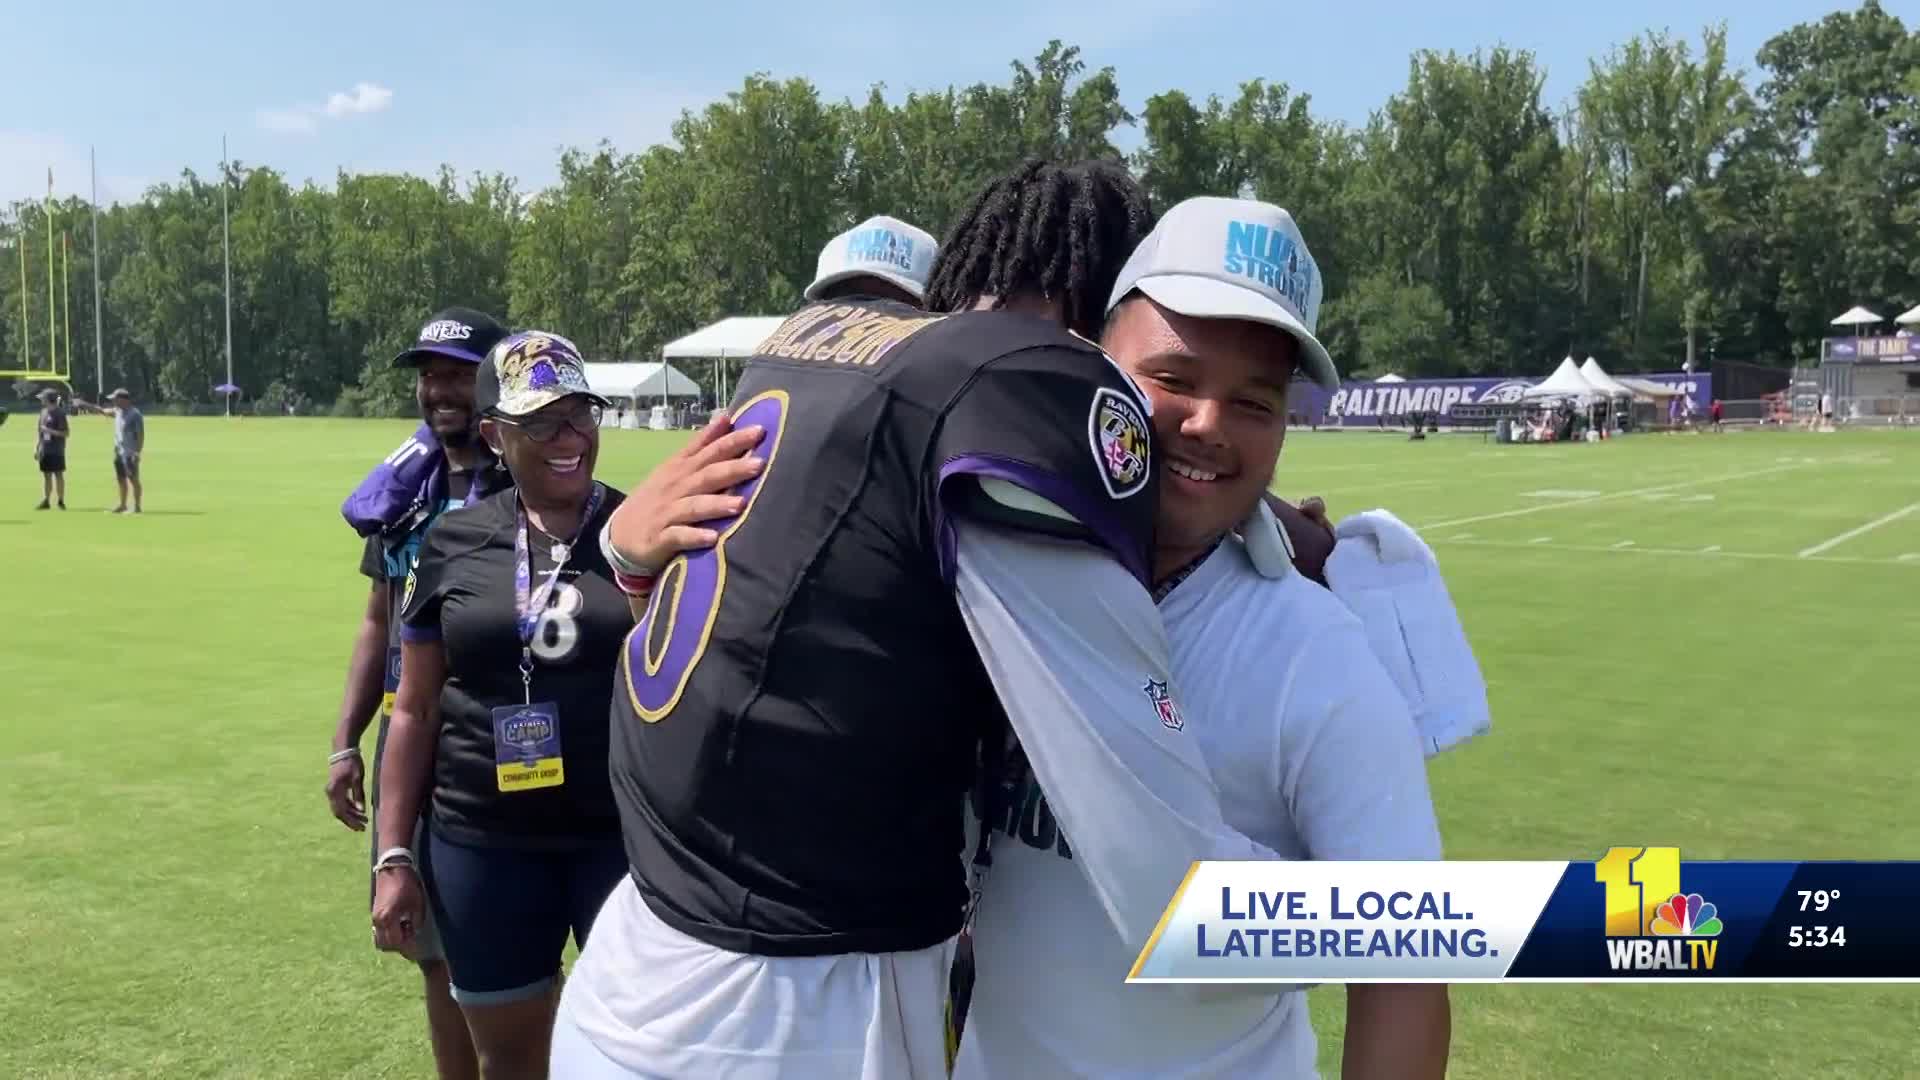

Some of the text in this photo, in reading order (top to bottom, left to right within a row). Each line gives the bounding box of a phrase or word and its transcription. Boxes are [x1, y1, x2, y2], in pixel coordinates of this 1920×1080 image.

[420, 319, 474, 342] RAVENS
[1329, 385, 1477, 417] BALTIMORE
[1106, 398, 1146, 440] RAVENS
[530, 582, 583, 660] 8
[506, 725, 550, 742] CAMP
